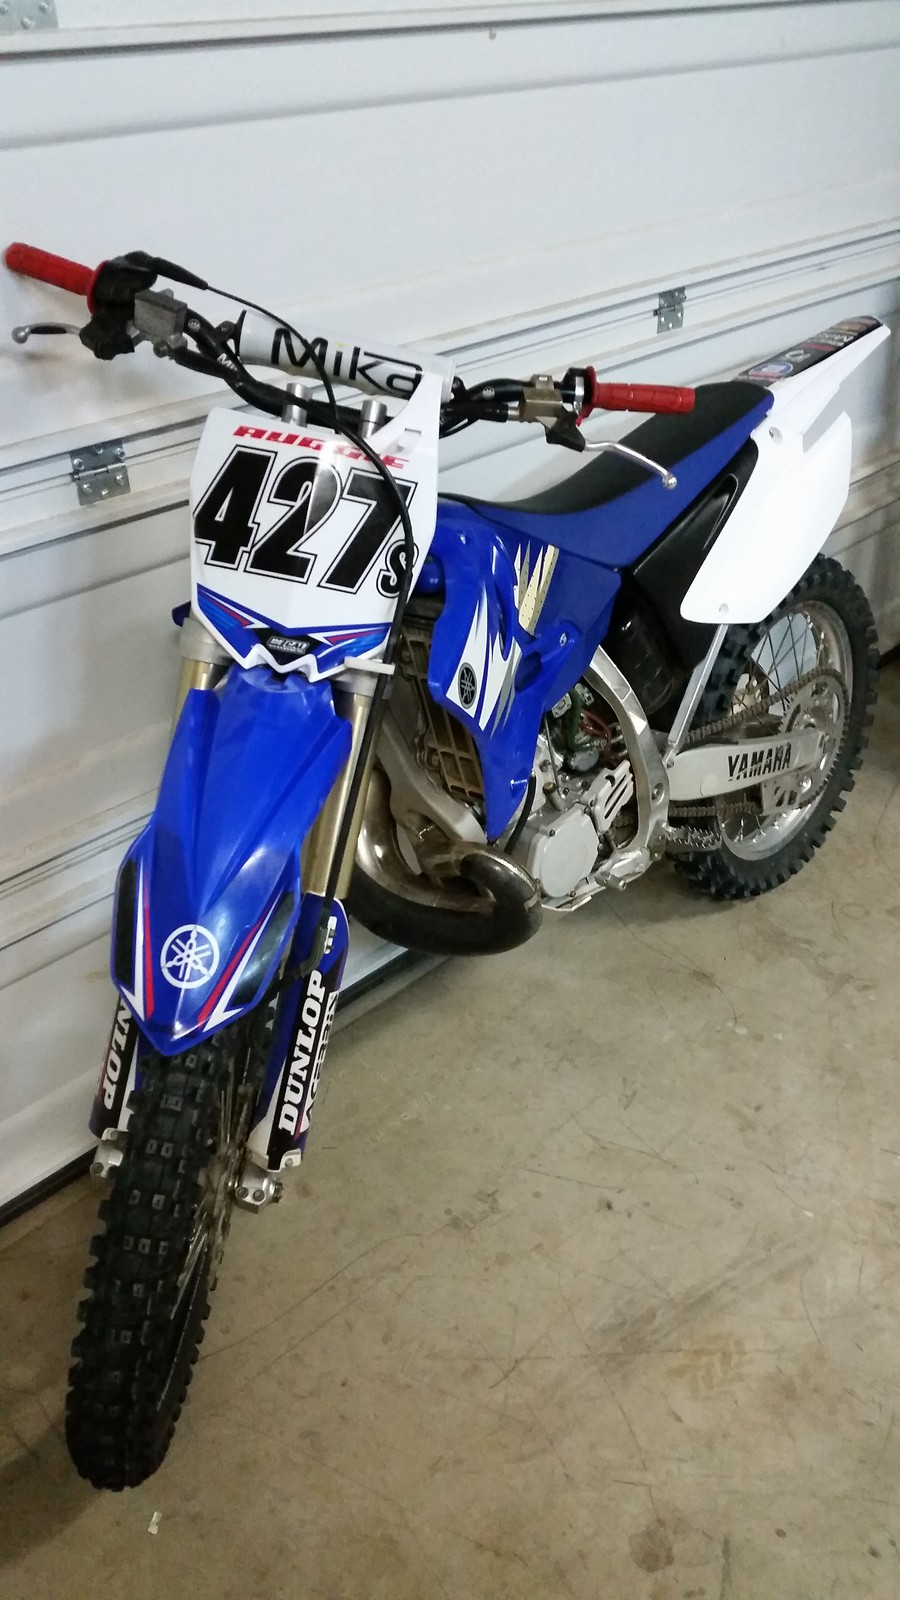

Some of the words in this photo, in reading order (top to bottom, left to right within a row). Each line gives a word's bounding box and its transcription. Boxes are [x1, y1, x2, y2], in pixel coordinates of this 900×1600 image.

[271, 327, 423, 398] Mika
[728, 741, 792, 782] YAMAHA
[103, 999, 132, 1110] NLOP
[278, 969, 326, 1136] DUNLOP
